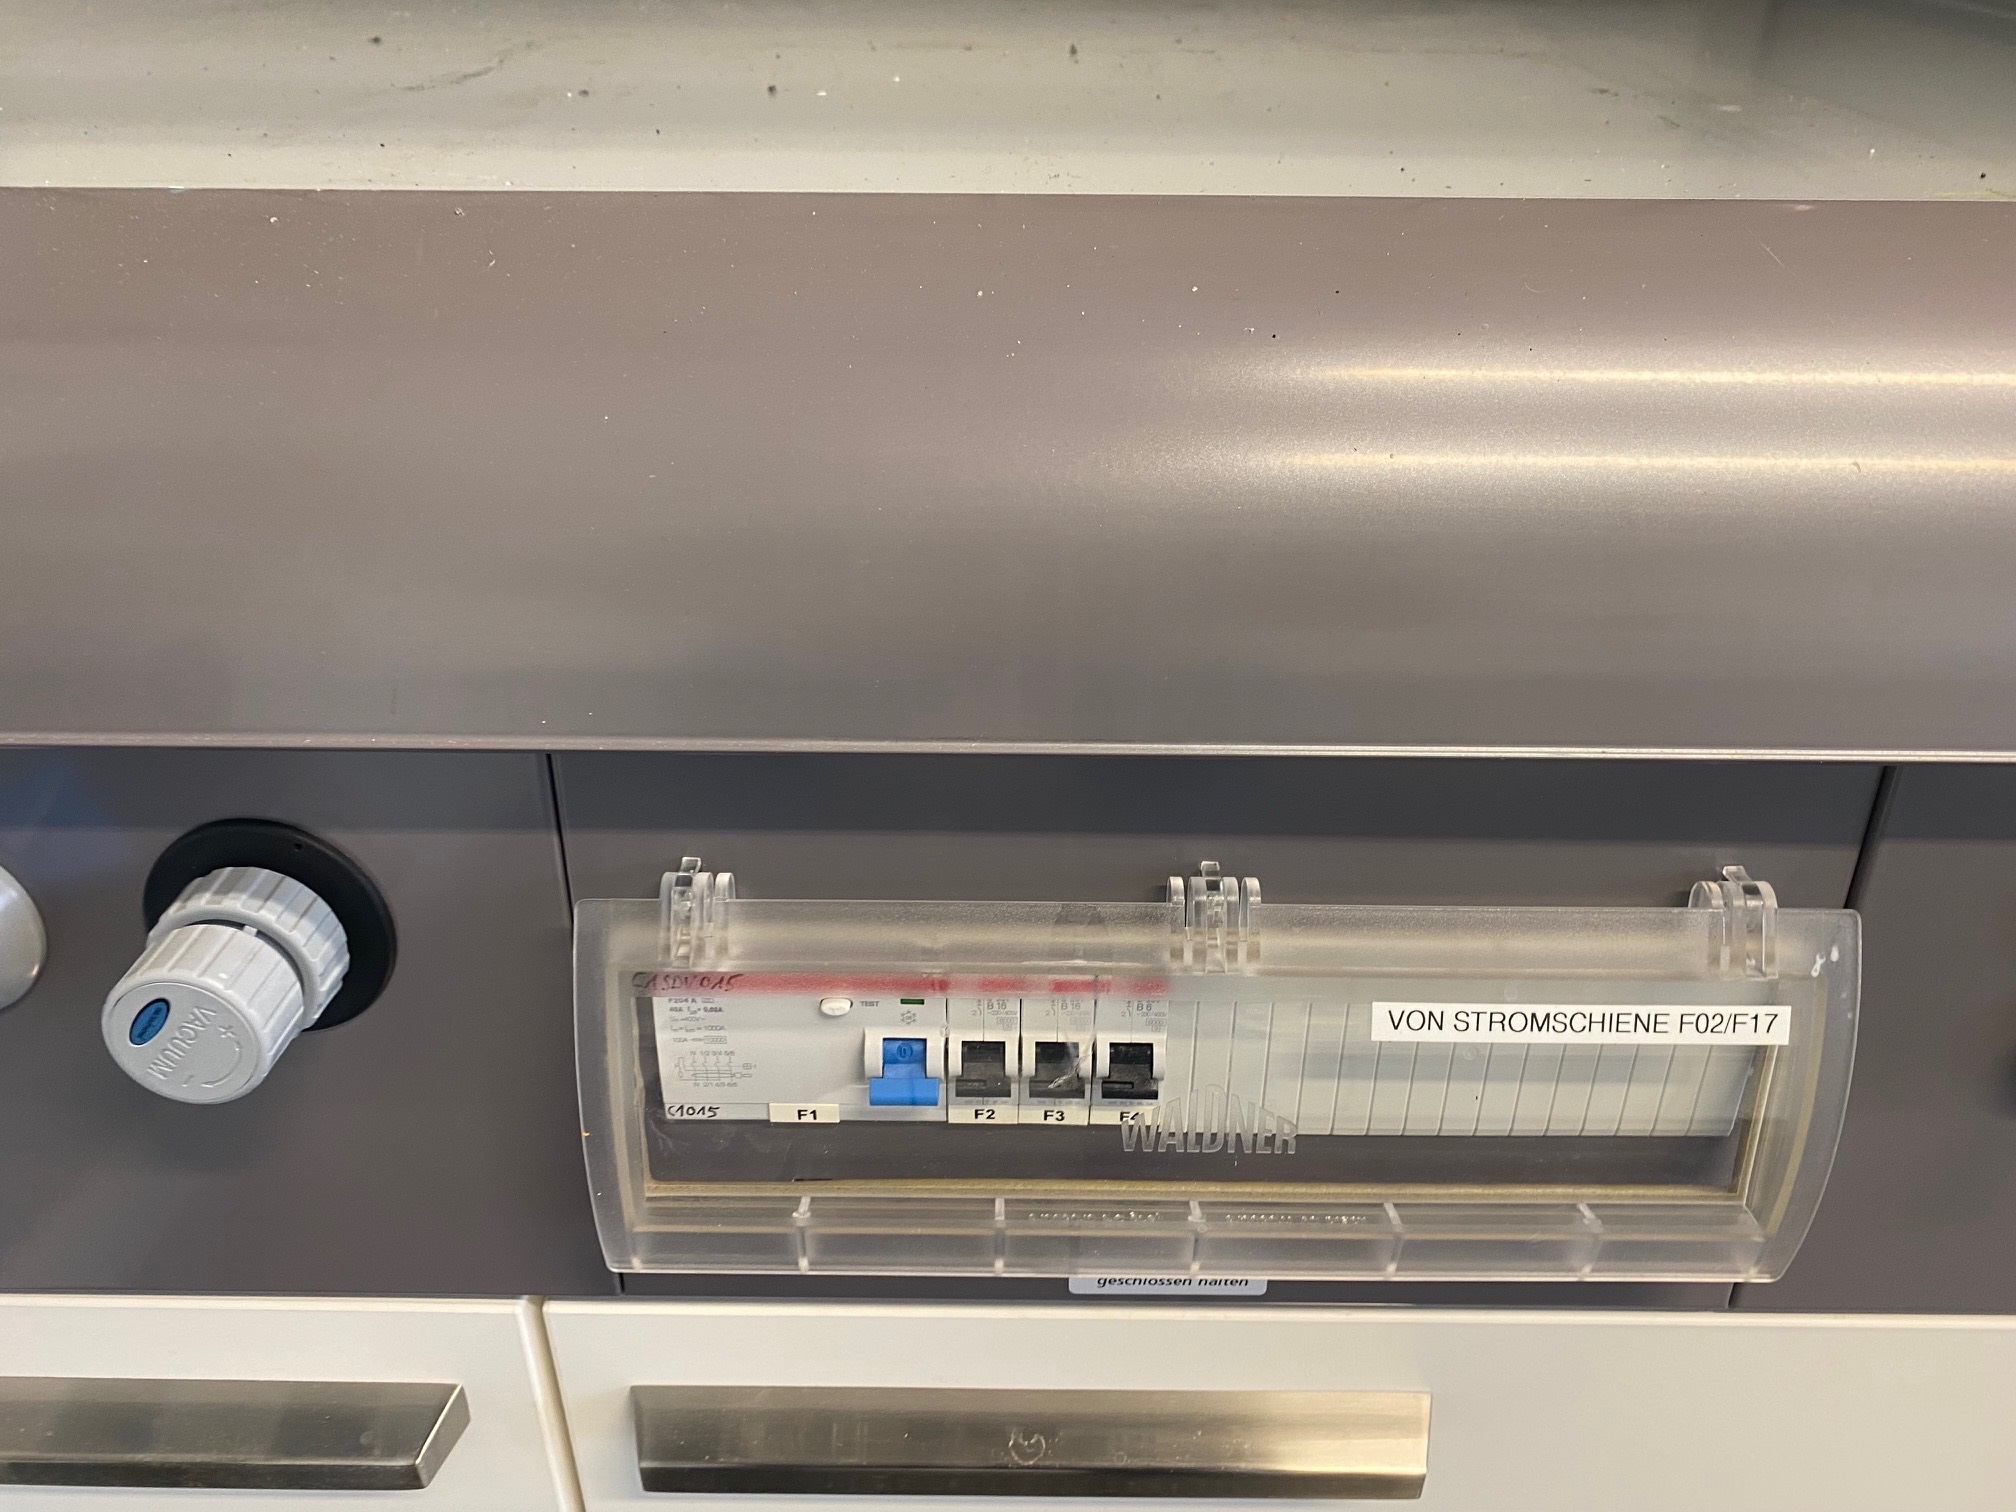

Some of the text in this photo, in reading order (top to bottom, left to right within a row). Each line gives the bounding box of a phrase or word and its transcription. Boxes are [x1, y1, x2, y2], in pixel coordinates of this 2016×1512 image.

[986, 1001, 1007, 1010] B 16
[1061, 1002, 1081, 1011] B 16
[1136, 1003, 1152, 1012] B 6
[1388, 1009, 1779, 1035] VON STROMSCHIENE F02/F17
[146, 1005, 218, 1080] VACUUM
[797, 1109, 818, 1121] F1
[974, 1109, 996, 1120] F2
[1043, 1110, 1066, 1122] F3
[1120, 1084, 1298, 1154] WALDNER
